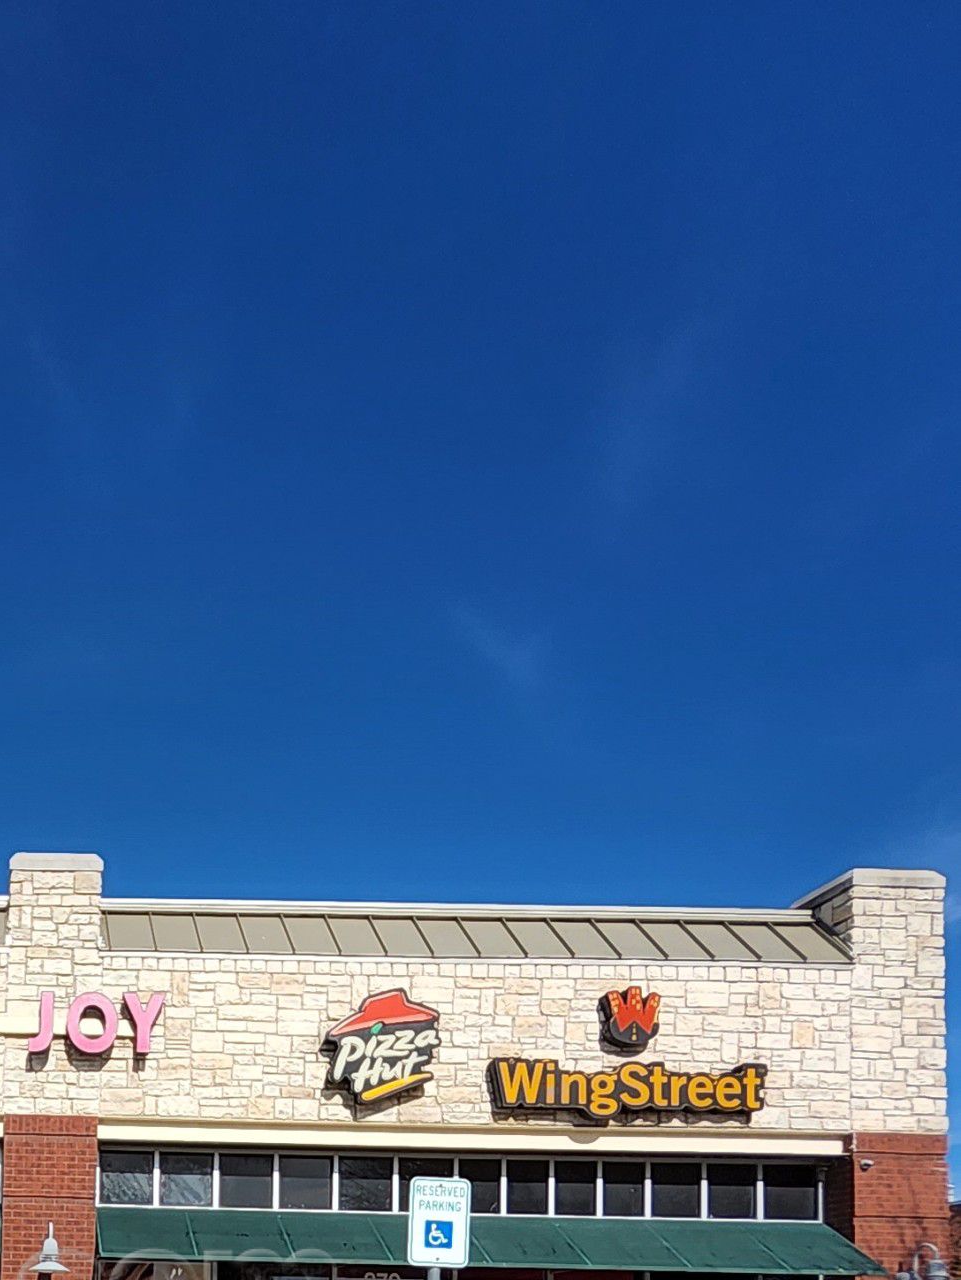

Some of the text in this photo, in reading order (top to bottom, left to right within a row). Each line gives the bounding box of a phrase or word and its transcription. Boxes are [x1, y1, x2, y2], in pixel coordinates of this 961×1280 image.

[28, 991, 166, 1054] JOY
[333, 1023, 440, 1083] Pizza
[351, 1051, 429, 1093] Hut
[501, 1061, 763, 1115] WingStreet
[415, 1183, 466, 1198] RESERVED
[418, 1199, 462, 1212] PARKING
